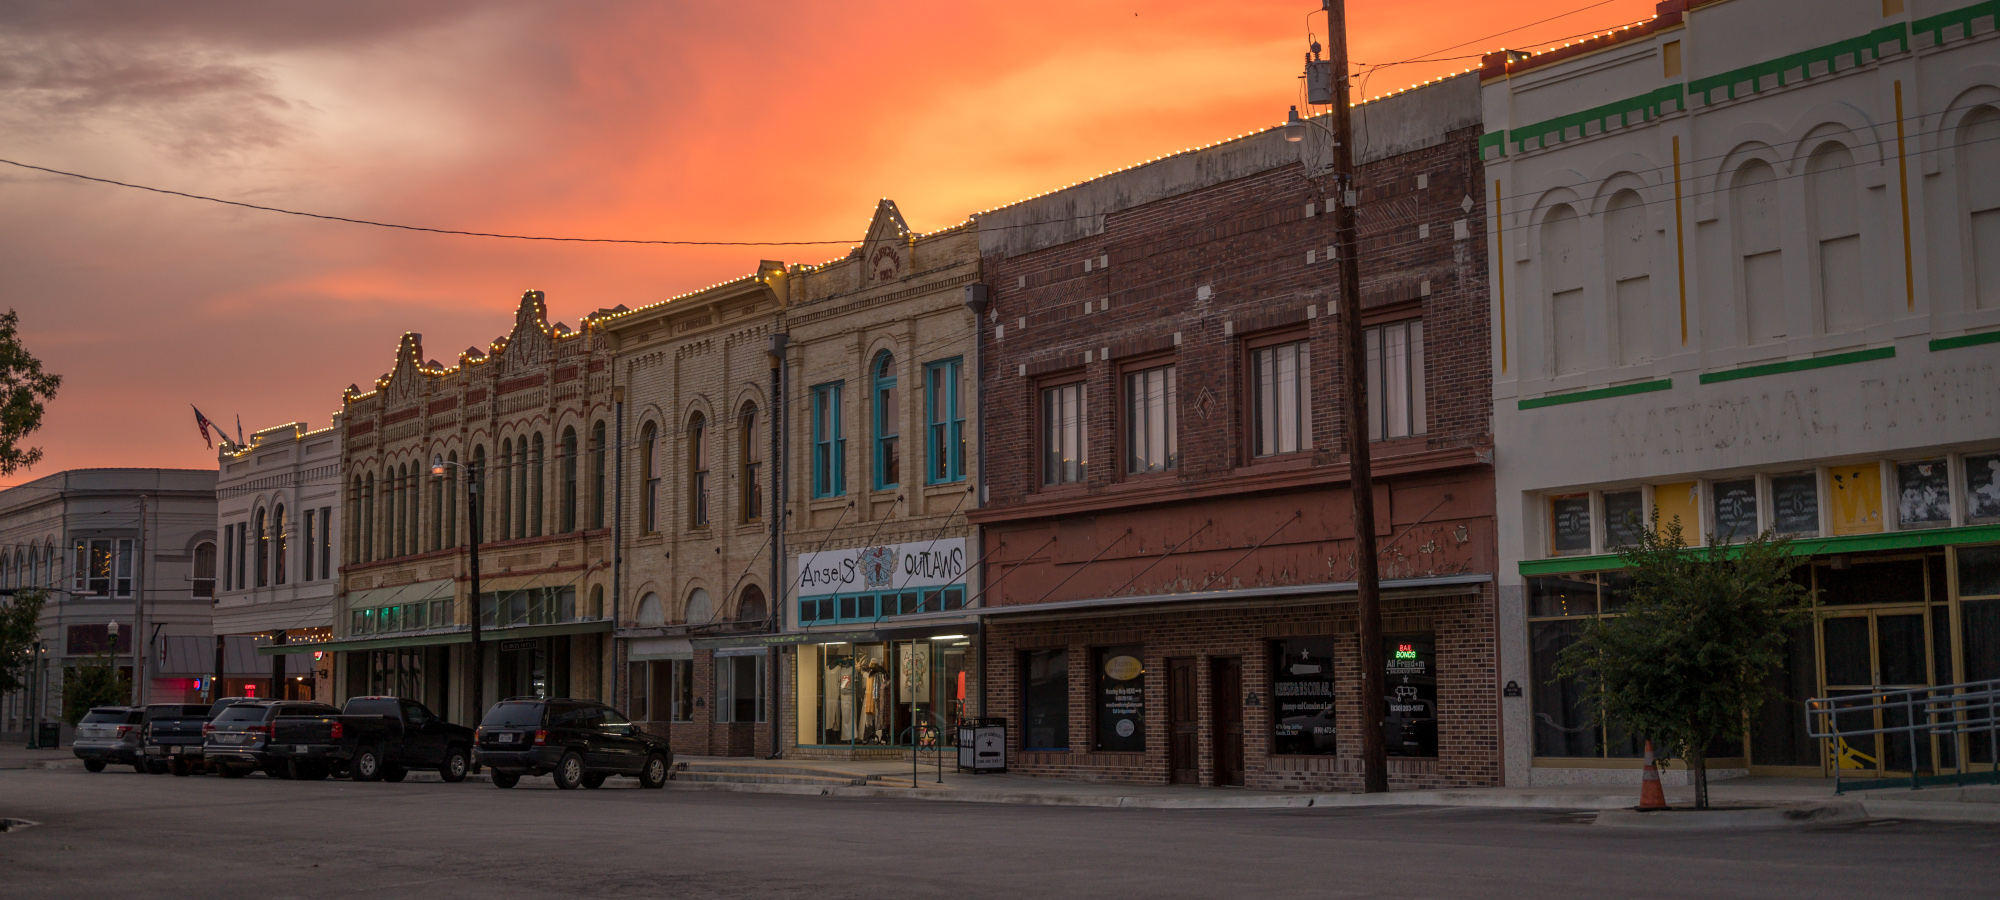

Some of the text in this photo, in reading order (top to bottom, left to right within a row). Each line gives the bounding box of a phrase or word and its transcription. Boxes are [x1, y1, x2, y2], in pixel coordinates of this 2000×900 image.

[905, 547, 963, 580] OUTLAWS
[1399, 644, 1413, 652] BAIL
[1395, 651, 1416, 659] BONDS
[1387, 659, 1396, 668] All
